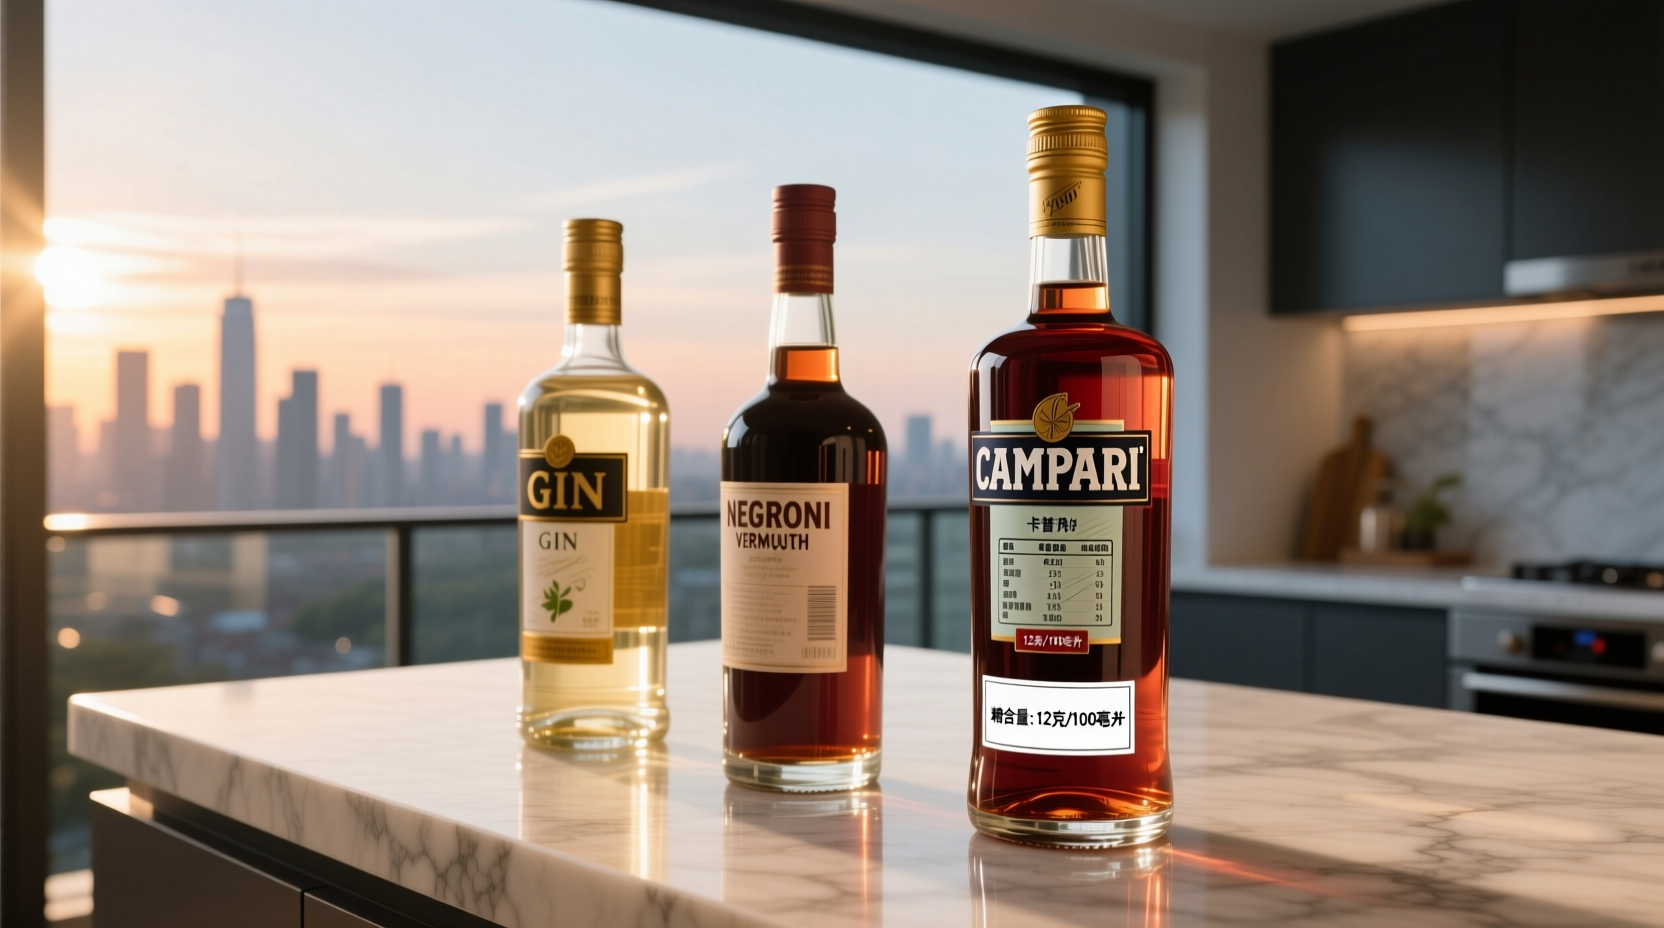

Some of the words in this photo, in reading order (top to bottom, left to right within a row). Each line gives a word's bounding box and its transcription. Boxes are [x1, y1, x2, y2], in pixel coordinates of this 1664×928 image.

[527, 470, 606, 510] GIN
[727, 500, 831, 529] NEGRONI
[538, 532, 577, 551] GIN
